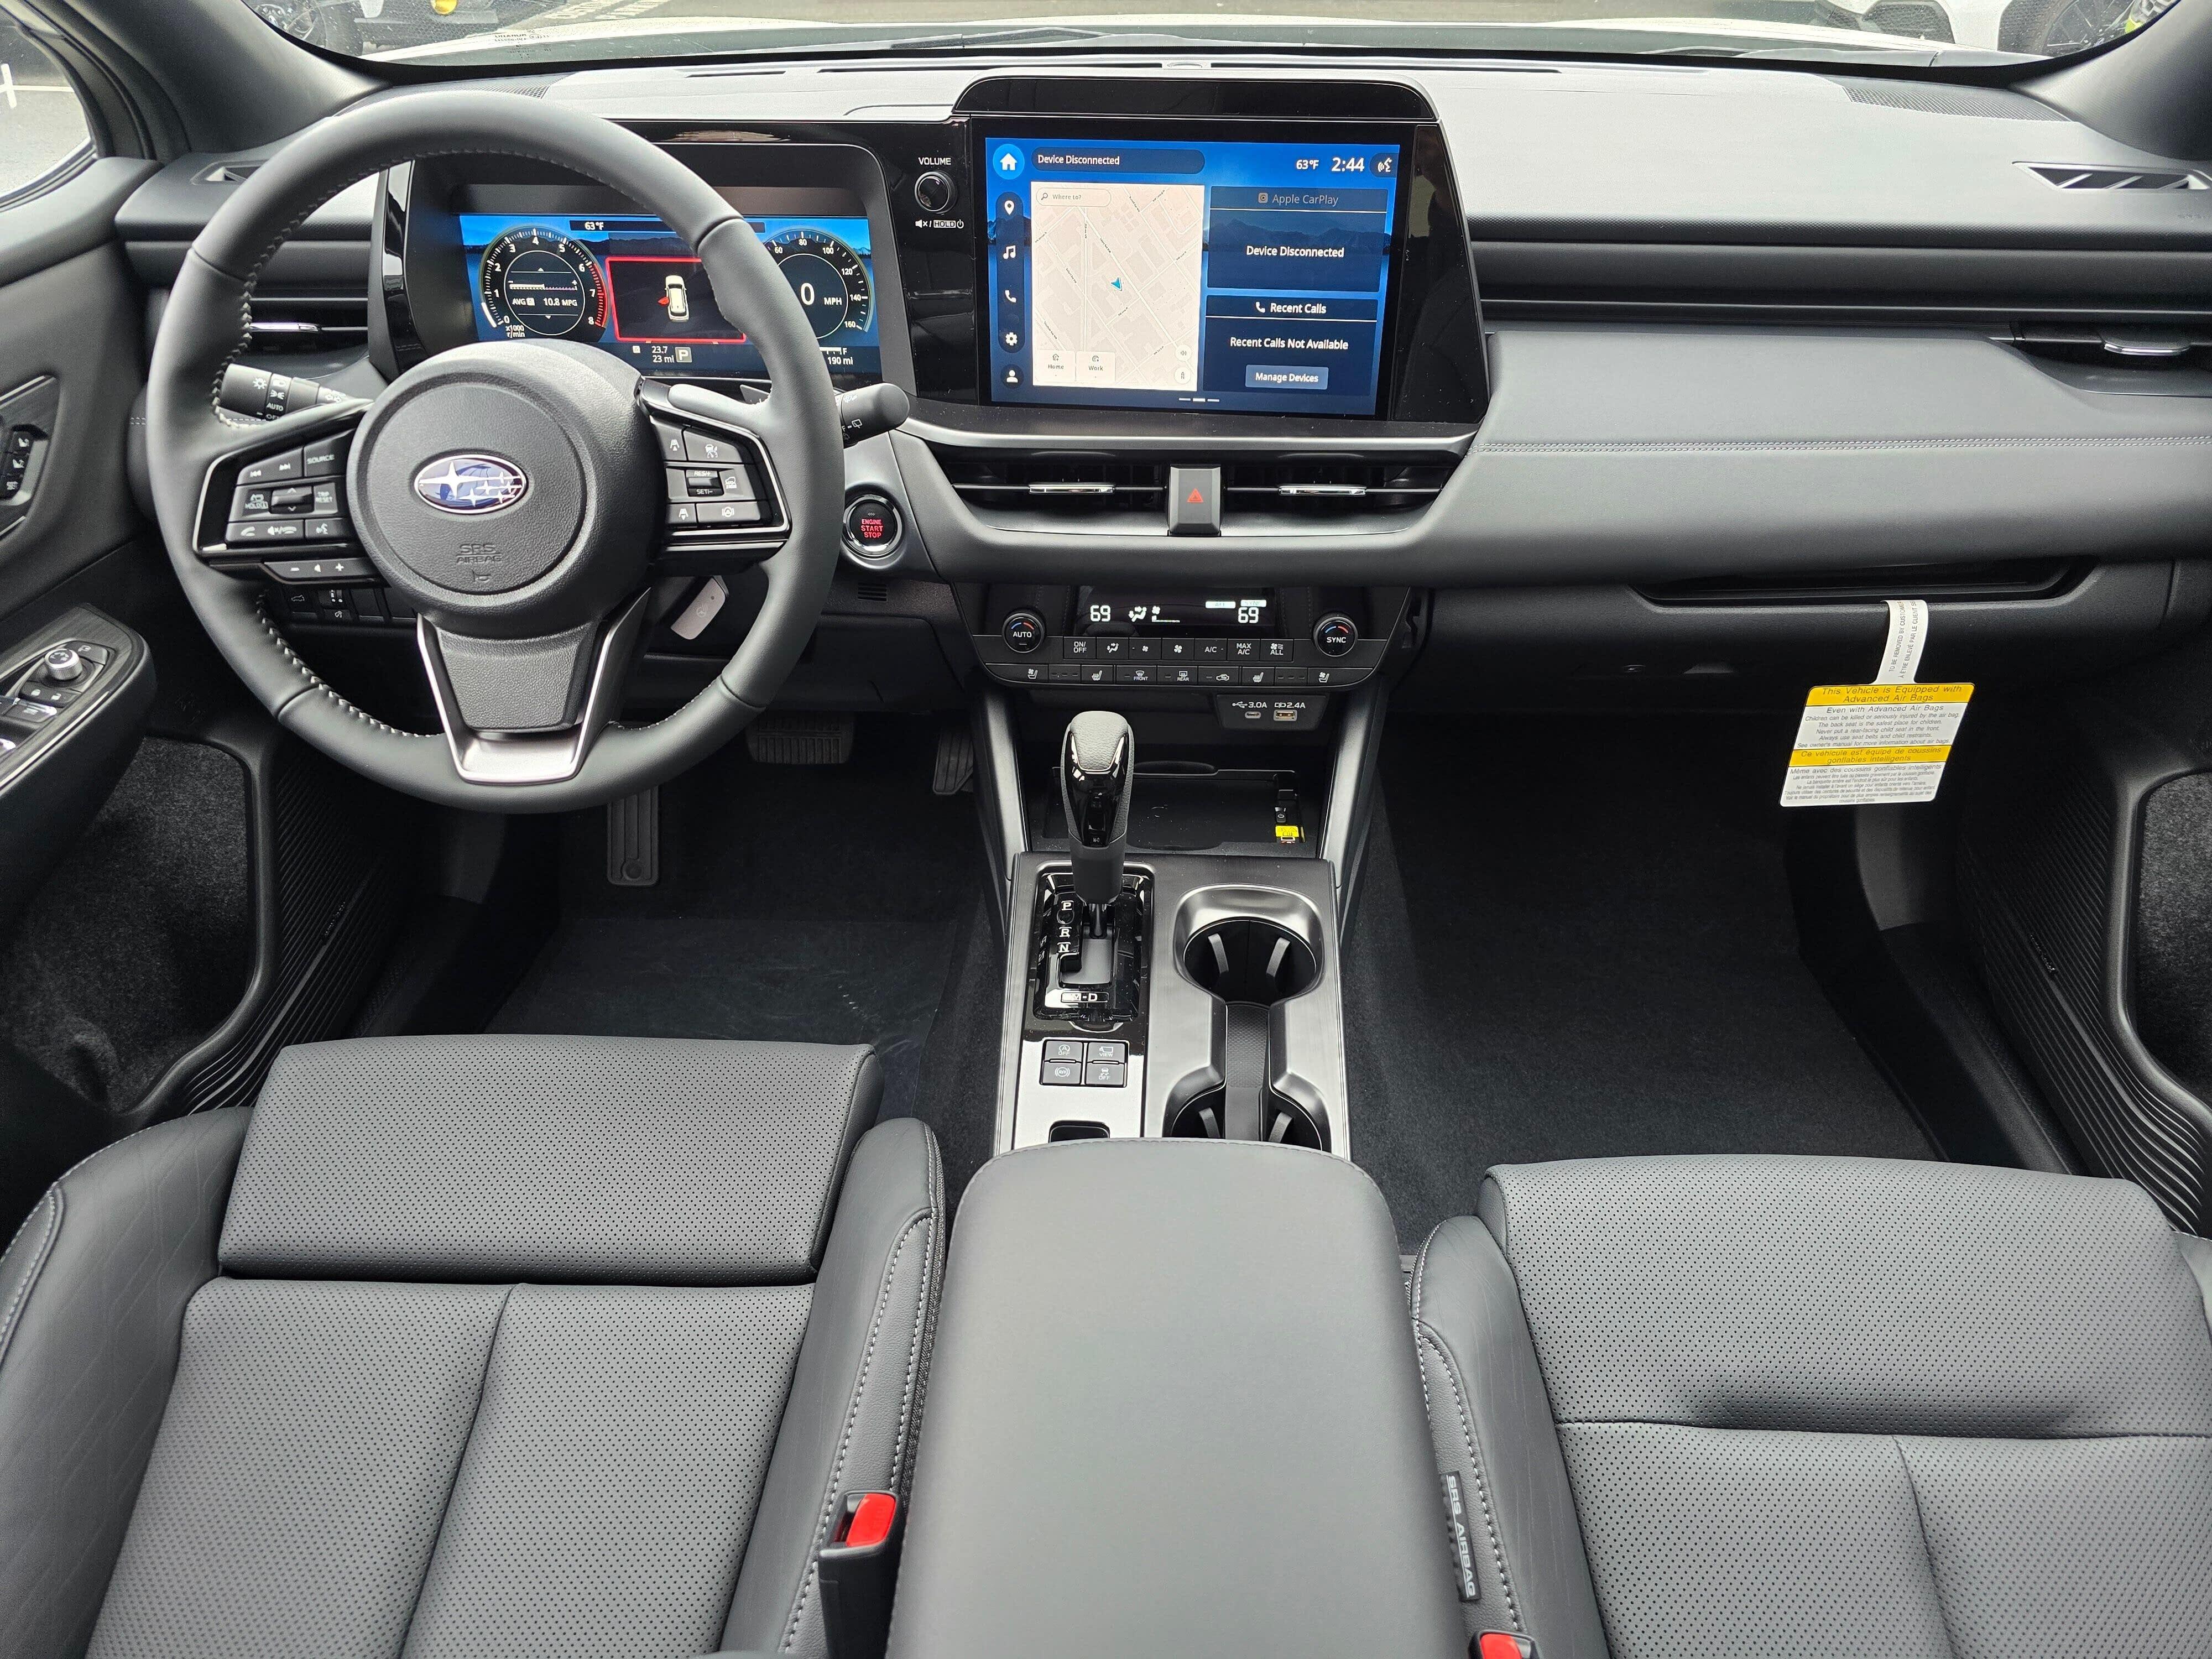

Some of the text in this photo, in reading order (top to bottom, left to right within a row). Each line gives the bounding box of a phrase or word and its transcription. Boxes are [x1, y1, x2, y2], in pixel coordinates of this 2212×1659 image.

[918, 157, 951, 165] VOLUME
[1038, 155, 1120, 165] Device Disconnected
[1296, 159, 1319, 170] 63°F
[1331, 157, 1365, 172] 2:44
[1272, 194, 1338, 207] Apple CarPlay
[585, 222, 604, 230] 63°F
[533, 237, 539, 246] 4
[509, 244, 515, 253] 3
[559, 244, 565, 253] 5
[1246, 246, 1344, 258] Device Disconnected
[494, 263, 501, 272] 2
[801, 283, 815, 305] 0
[1270, 302, 1327, 314] Recent Calls
[504, 315, 510, 324] 0
[1230, 337, 1349, 350] Recent Calls Not Available
[651, 346, 668, 354] 23.7
[678, 349, 688, 361] P
[827, 357, 853, 365] 190 mi
[1255, 372, 1319, 383] Manage Devices
[267, 402, 284, 412] AUTO
[307, 455, 335, 465] SOURCE
[460, 544, 496, 554] SRS
[1090, 605, 1111, 622] 69
[1238, 607, 1259, 623] 69
[1893, 635, 1903, 658] REMOVED
[1910, 693, 1934, 702] Bags
[1827, 757, 1866, 765] gonflables
[1061, 902, 1072, 911] P
[1059, 928, 1070, 937] R
[1058, 943, 1070, 952] N
[1449, 1475, 1475, 1596] SRS AIRBAG
